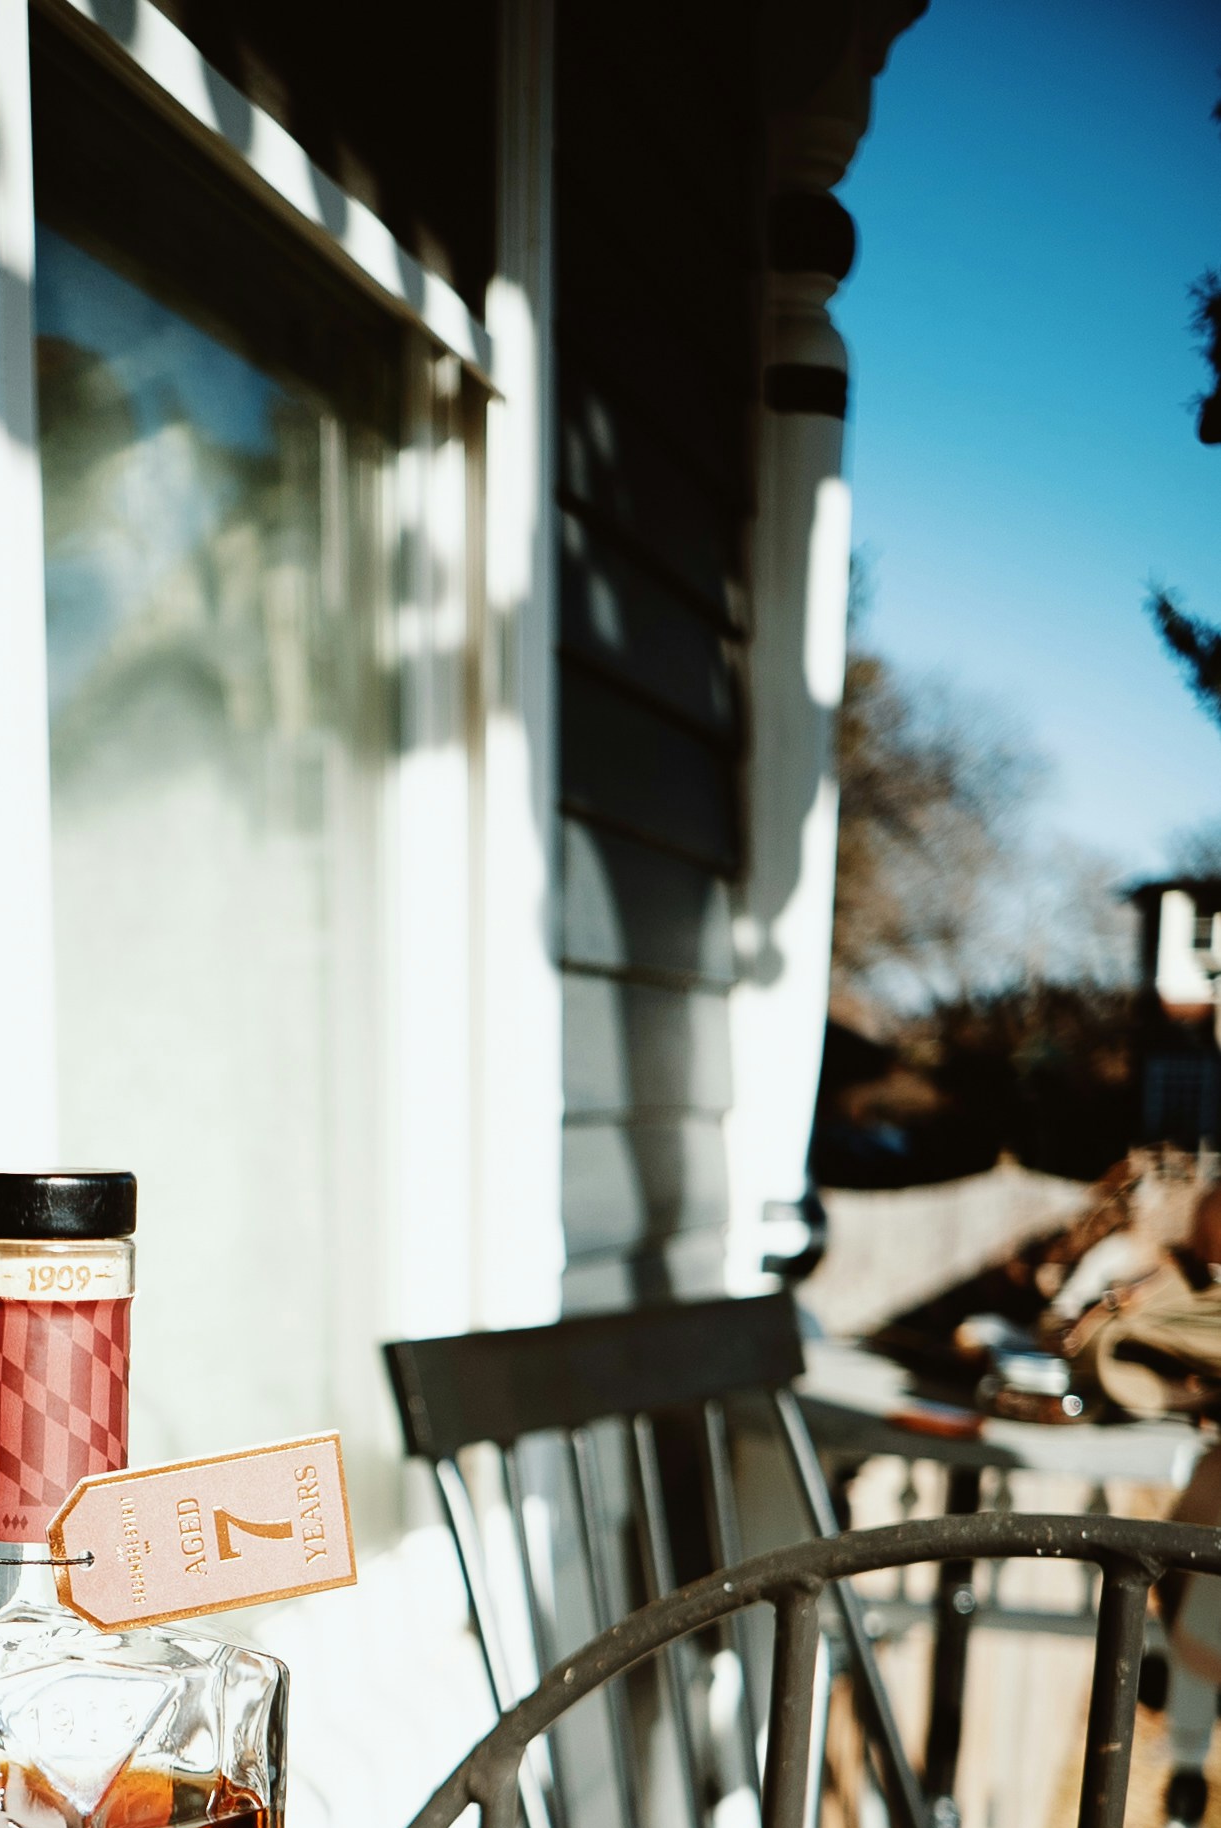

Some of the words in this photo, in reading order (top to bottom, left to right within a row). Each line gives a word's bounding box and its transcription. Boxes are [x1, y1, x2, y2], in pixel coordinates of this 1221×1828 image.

[27, 1266, 91, 1292] 1909
[176, 1497, 208, 1577] AGED
[212, 1505, 294, 1563] 7
[294, 1464, 328, 1567] YEARS
